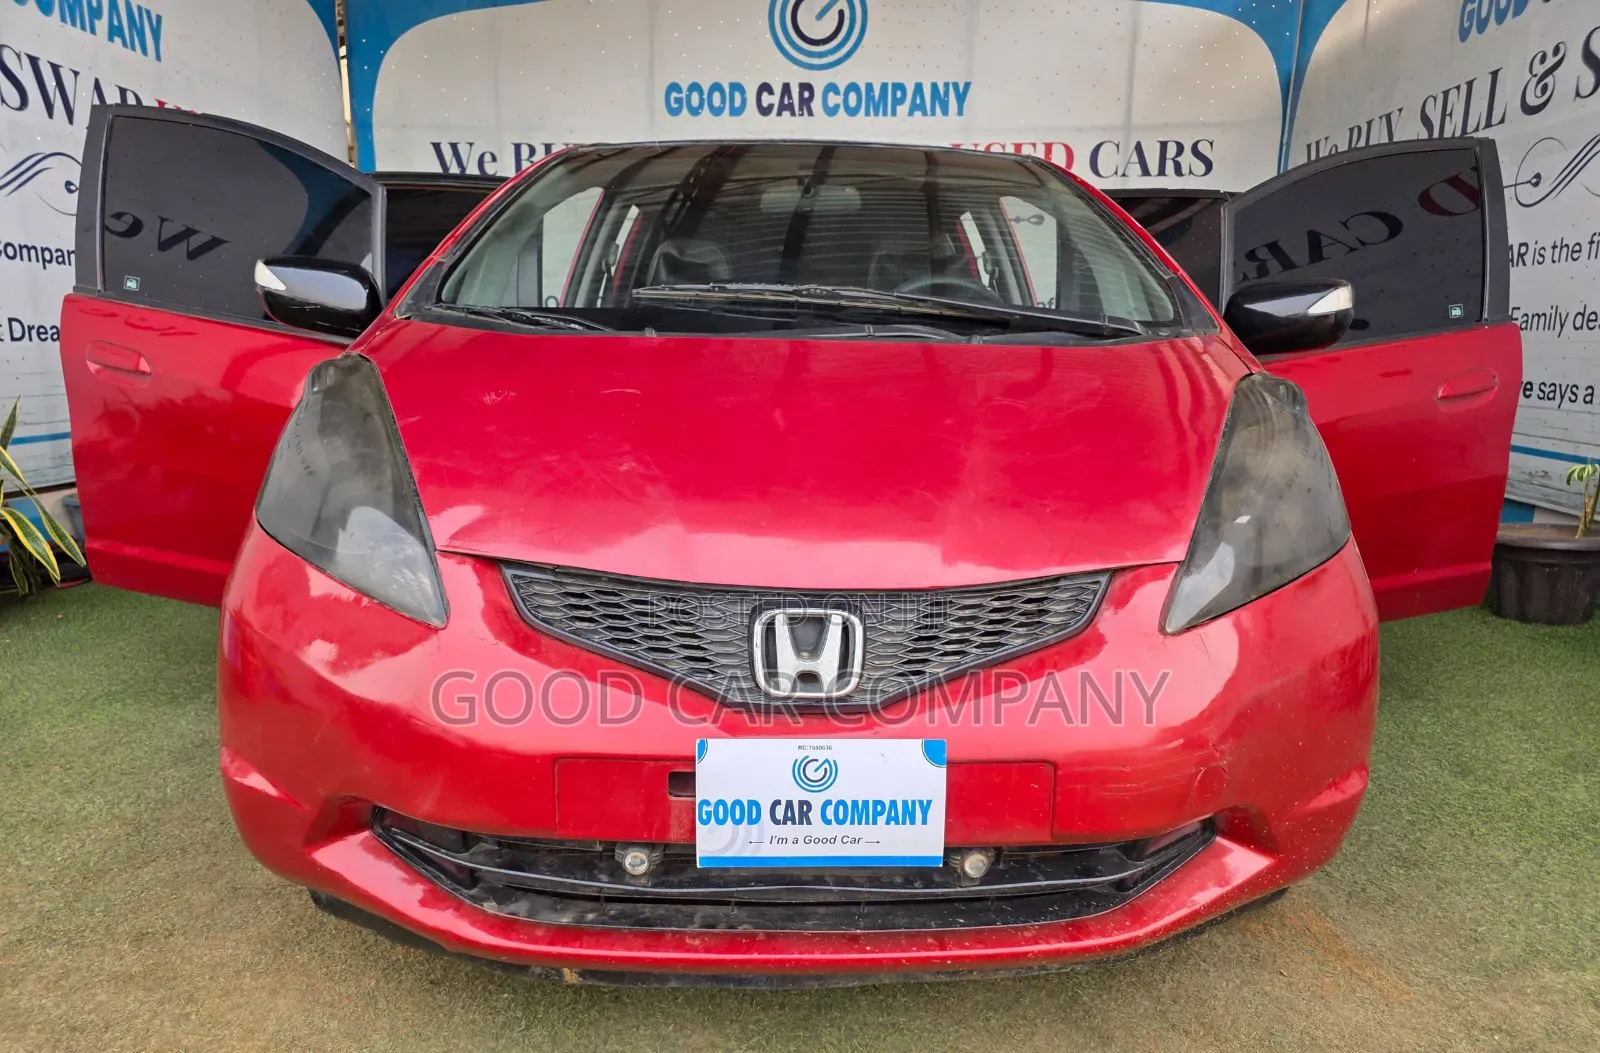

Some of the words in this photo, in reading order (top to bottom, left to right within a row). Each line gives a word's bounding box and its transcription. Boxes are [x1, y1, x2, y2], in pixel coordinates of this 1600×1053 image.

[12, 0, 163, 63] MPANY
[664, 81, 747, 118] GOOD
[755, 81, 815, 118] CAR
[821, 81, 972, 118] COMPANY
[1417, 67, 1508, 139] SELL
[1520, 41, 1567, 116] &
[430, 142, 499, 177] We
[1089, 139, 1215, 179] CARS
[1532, 240, 1546, 266] is
[1551, 237, 1583, 264] the
[1510, 305, 1570, 338] Family
[1572, 304, 1600, 331] de
[1536, 381, 1579, 409] says
[1583, 384, 1595, 405] a
[698, 799, 762, 826] GOOD
[769, 799, 812, 826] CAR
[820, 799, 933, 826] COMPANY
[769, 834, 789, 845] I'm
[791, 837, 799, 845] a
[803, 834, 837, 845] Good
[840, 834, 863, 845] Car
